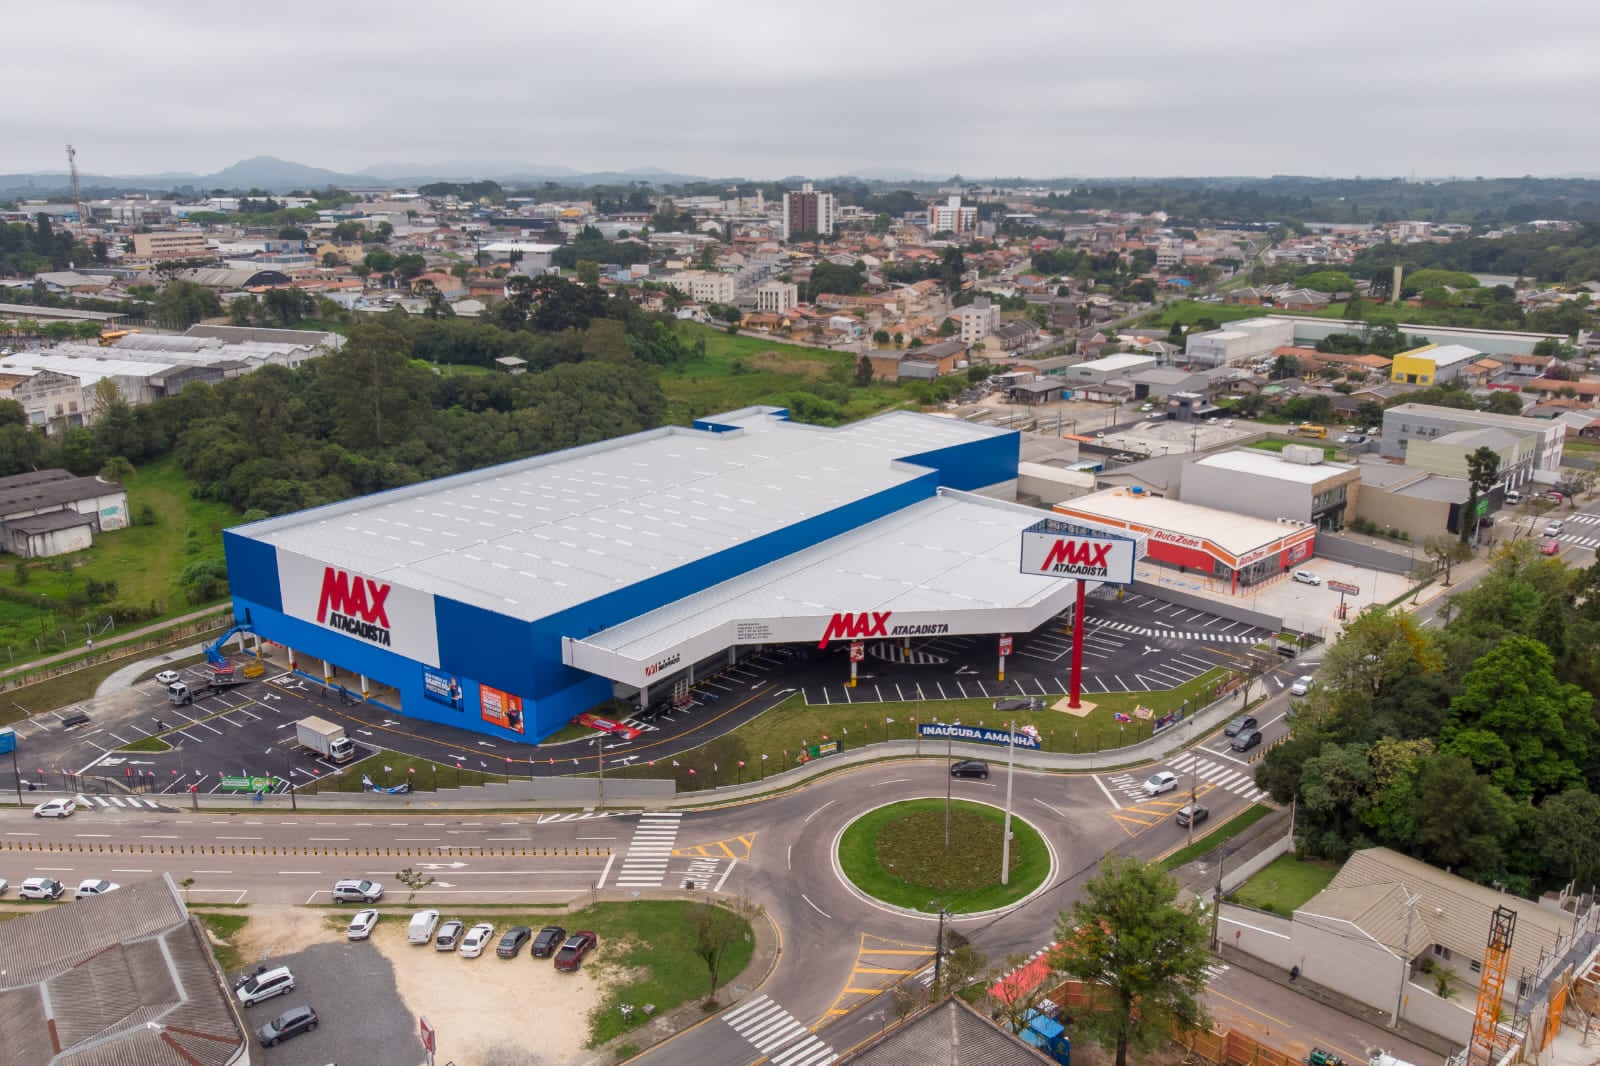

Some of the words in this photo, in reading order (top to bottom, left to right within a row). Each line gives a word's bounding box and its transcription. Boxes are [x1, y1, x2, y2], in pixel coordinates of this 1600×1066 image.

[1154, 531, 1199, 546] AutoZone
[1040, 539, 1112, 572] MAX
[1053, 563, 1107, 577] ATACADISTA
[316, 566, 391, 629] MAX
[329, 611, 391, 647] ATACADISTA
[817, 610, 892, 649] MAX
[891, 623, 948, 636] ATACADISTA
[923, 726, 982, 739] INAUGURA
